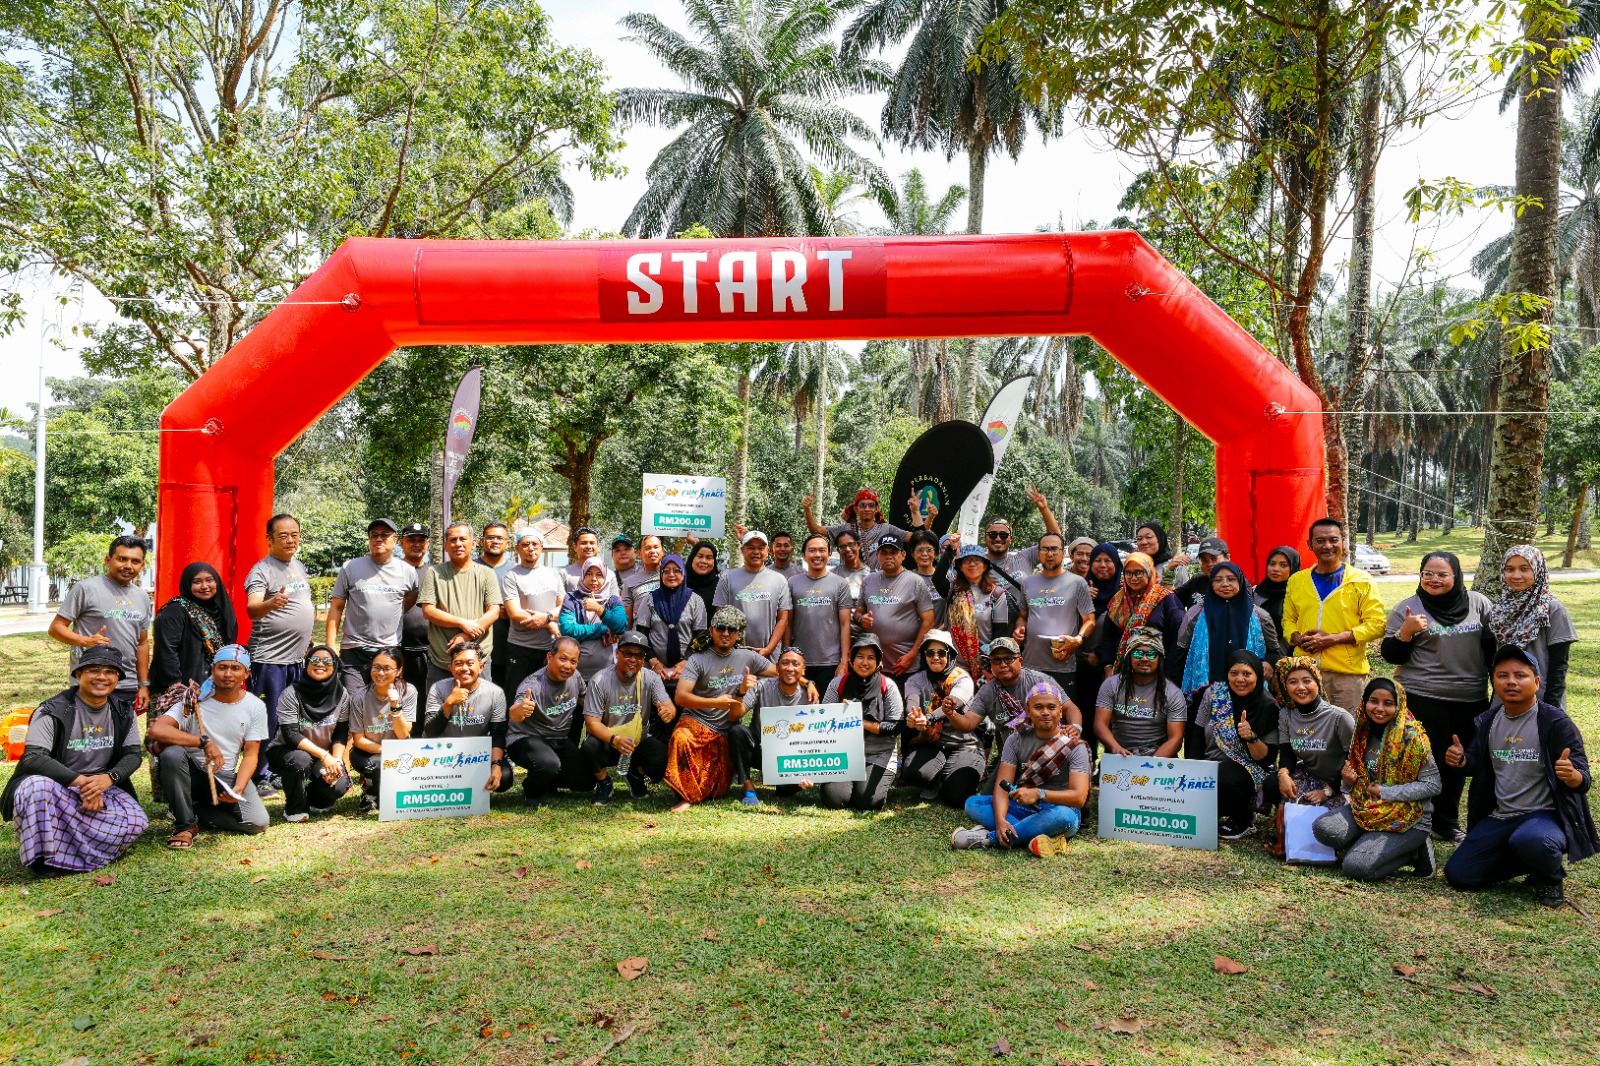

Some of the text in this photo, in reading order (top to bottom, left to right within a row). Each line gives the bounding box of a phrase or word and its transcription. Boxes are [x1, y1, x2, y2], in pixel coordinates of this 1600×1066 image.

[626, 250, 853, 314] START
[659, 515, 706, 526] RM200.00
[808, 720, 828, 730] FUN
[837, 719, 862, 730] RACE
[433, 755, 454, 766] FUN
[464, 753, 491, 765] RACE
[783, 757, 841, 769] RM300.00
[1153, 777, 1176, 786] FUN
[1187, 780, 1217, 790] RACE
[403, 792, 465, 805] RM500.00
[1122, 812, 1189, 830] RM200.00
